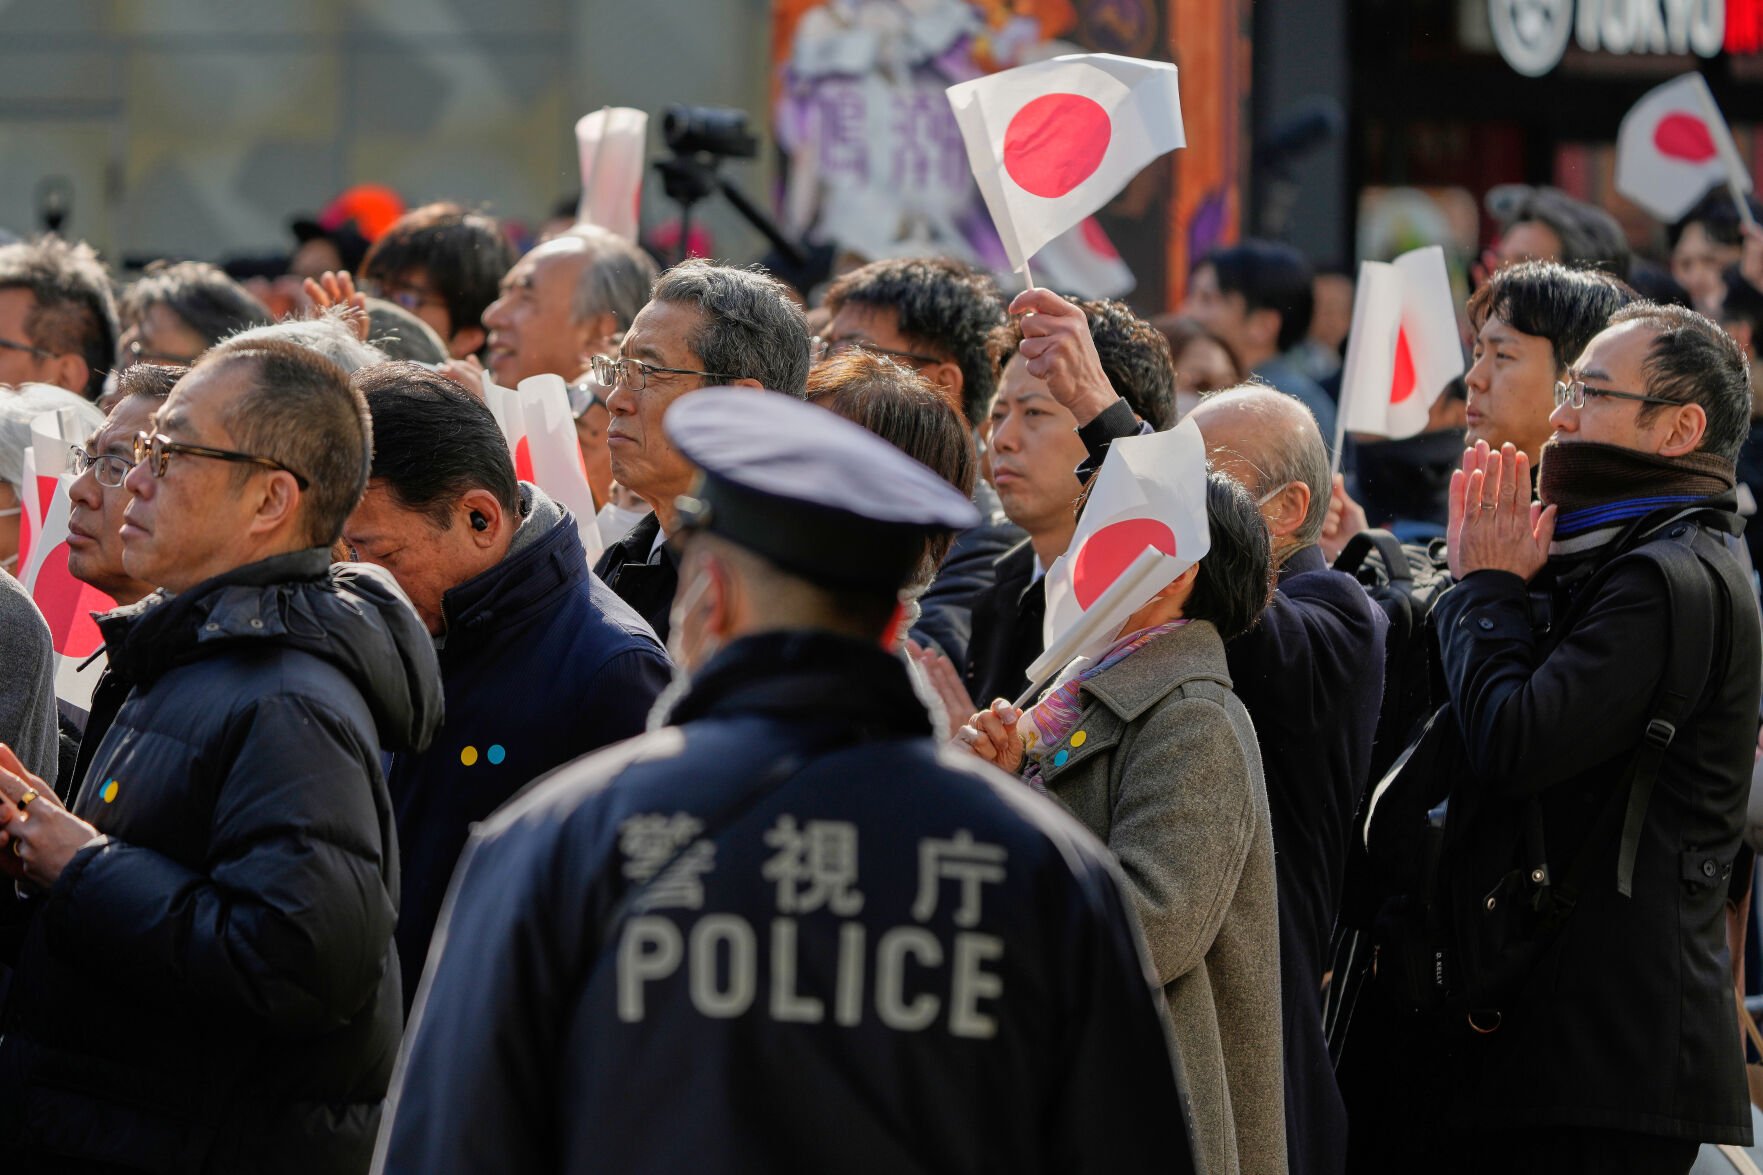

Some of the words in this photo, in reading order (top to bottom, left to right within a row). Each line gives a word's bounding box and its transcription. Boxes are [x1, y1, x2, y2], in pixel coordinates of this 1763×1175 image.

[618, 812, 1008, 927] 警視庁
[616, 913, 1004, 1038] POLICE
